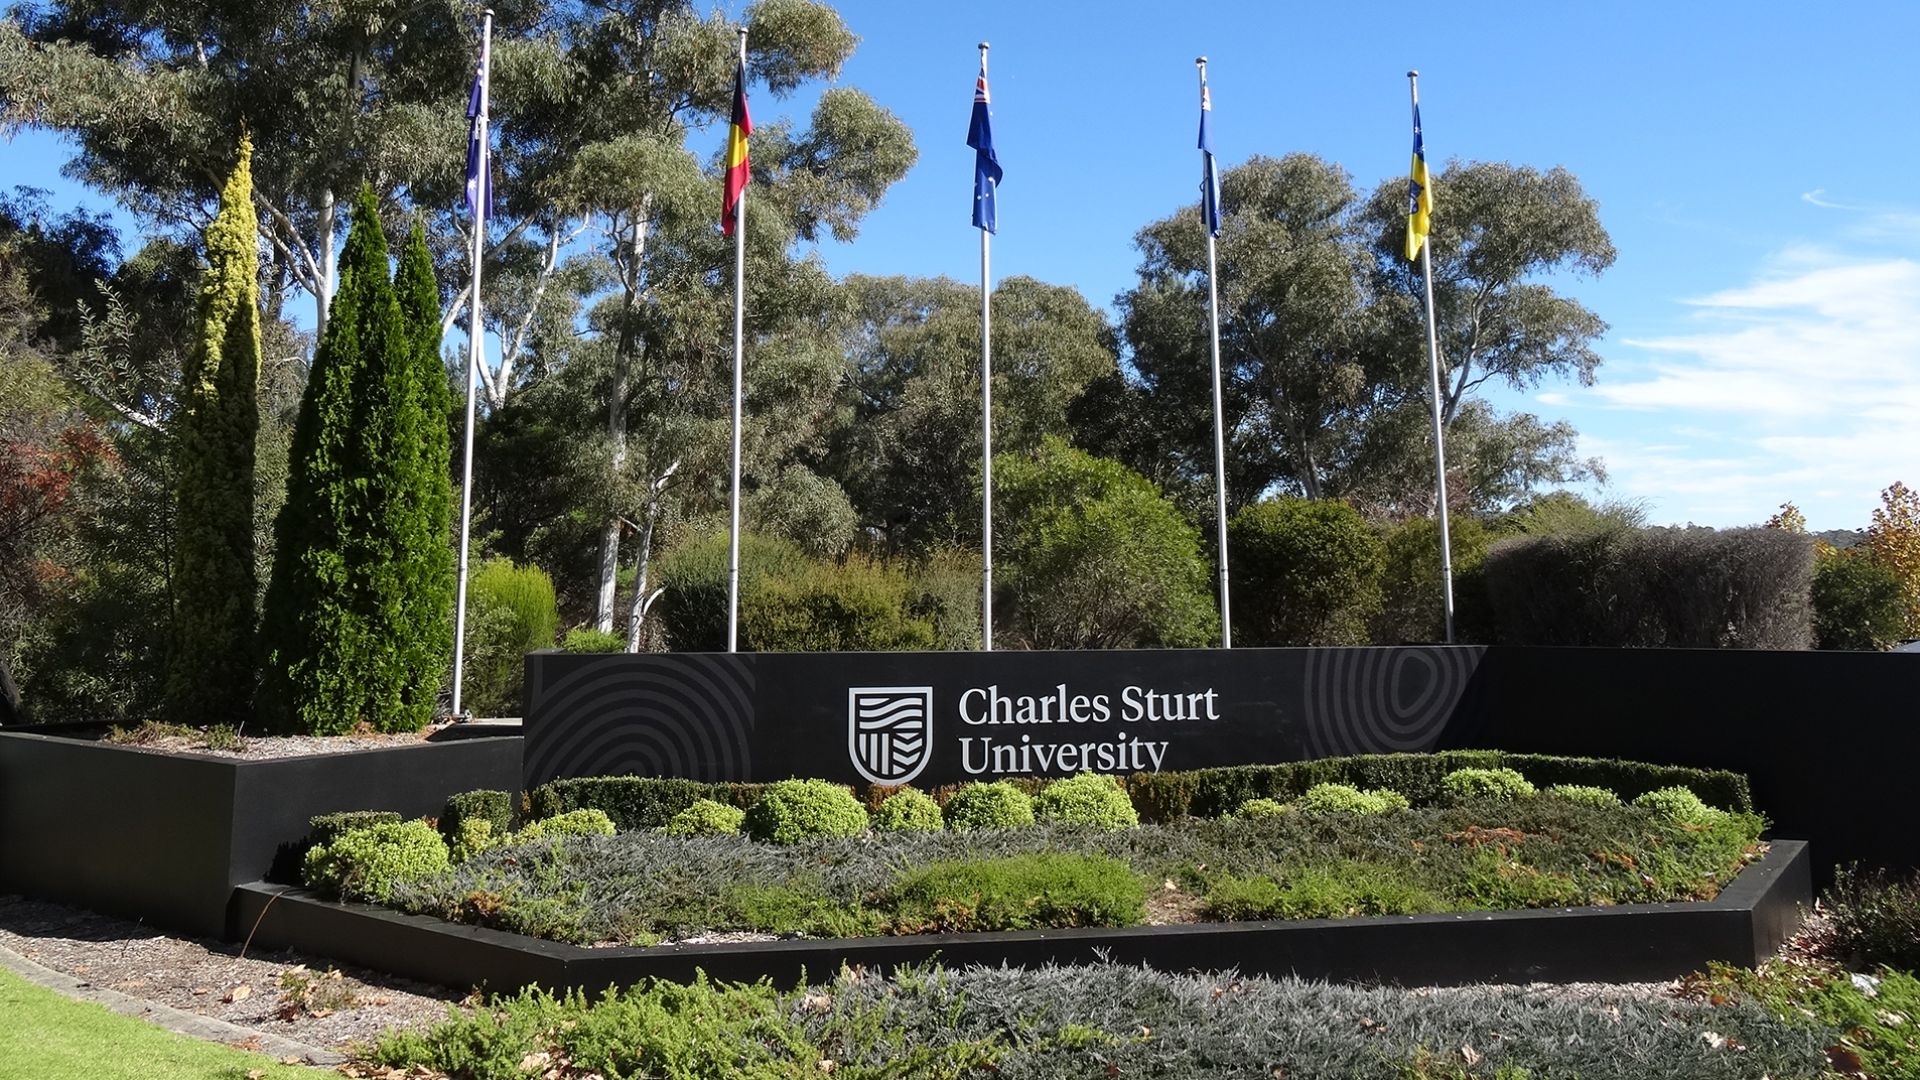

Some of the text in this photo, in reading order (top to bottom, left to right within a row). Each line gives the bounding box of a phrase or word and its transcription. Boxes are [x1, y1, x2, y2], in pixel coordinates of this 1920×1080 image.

[959, 684, 1220, 725] Charles Sturt
[959, 732, 1168, 776] University
